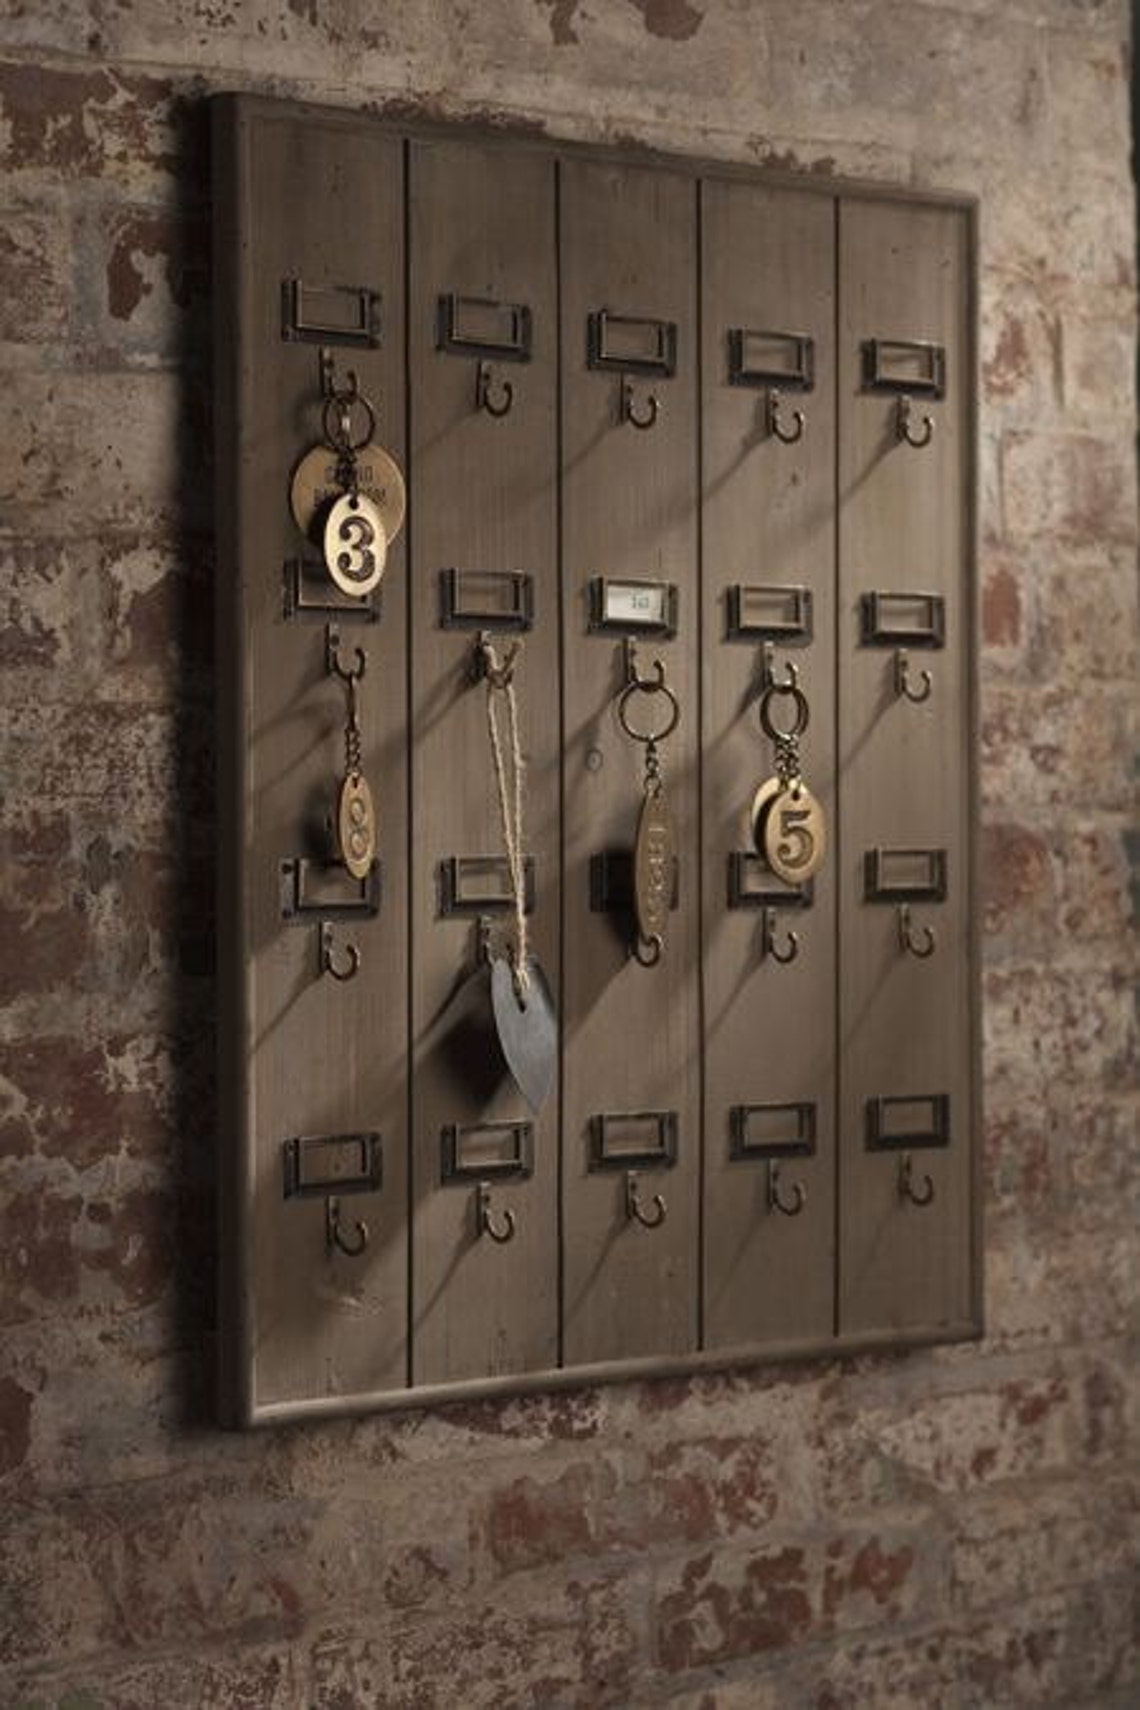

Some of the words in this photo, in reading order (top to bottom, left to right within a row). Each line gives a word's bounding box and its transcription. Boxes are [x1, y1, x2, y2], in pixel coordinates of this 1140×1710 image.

[337, 515, 376, 583] 3
[349, 798, 369, 860] 8
[777, 810, 814, 869] 5
